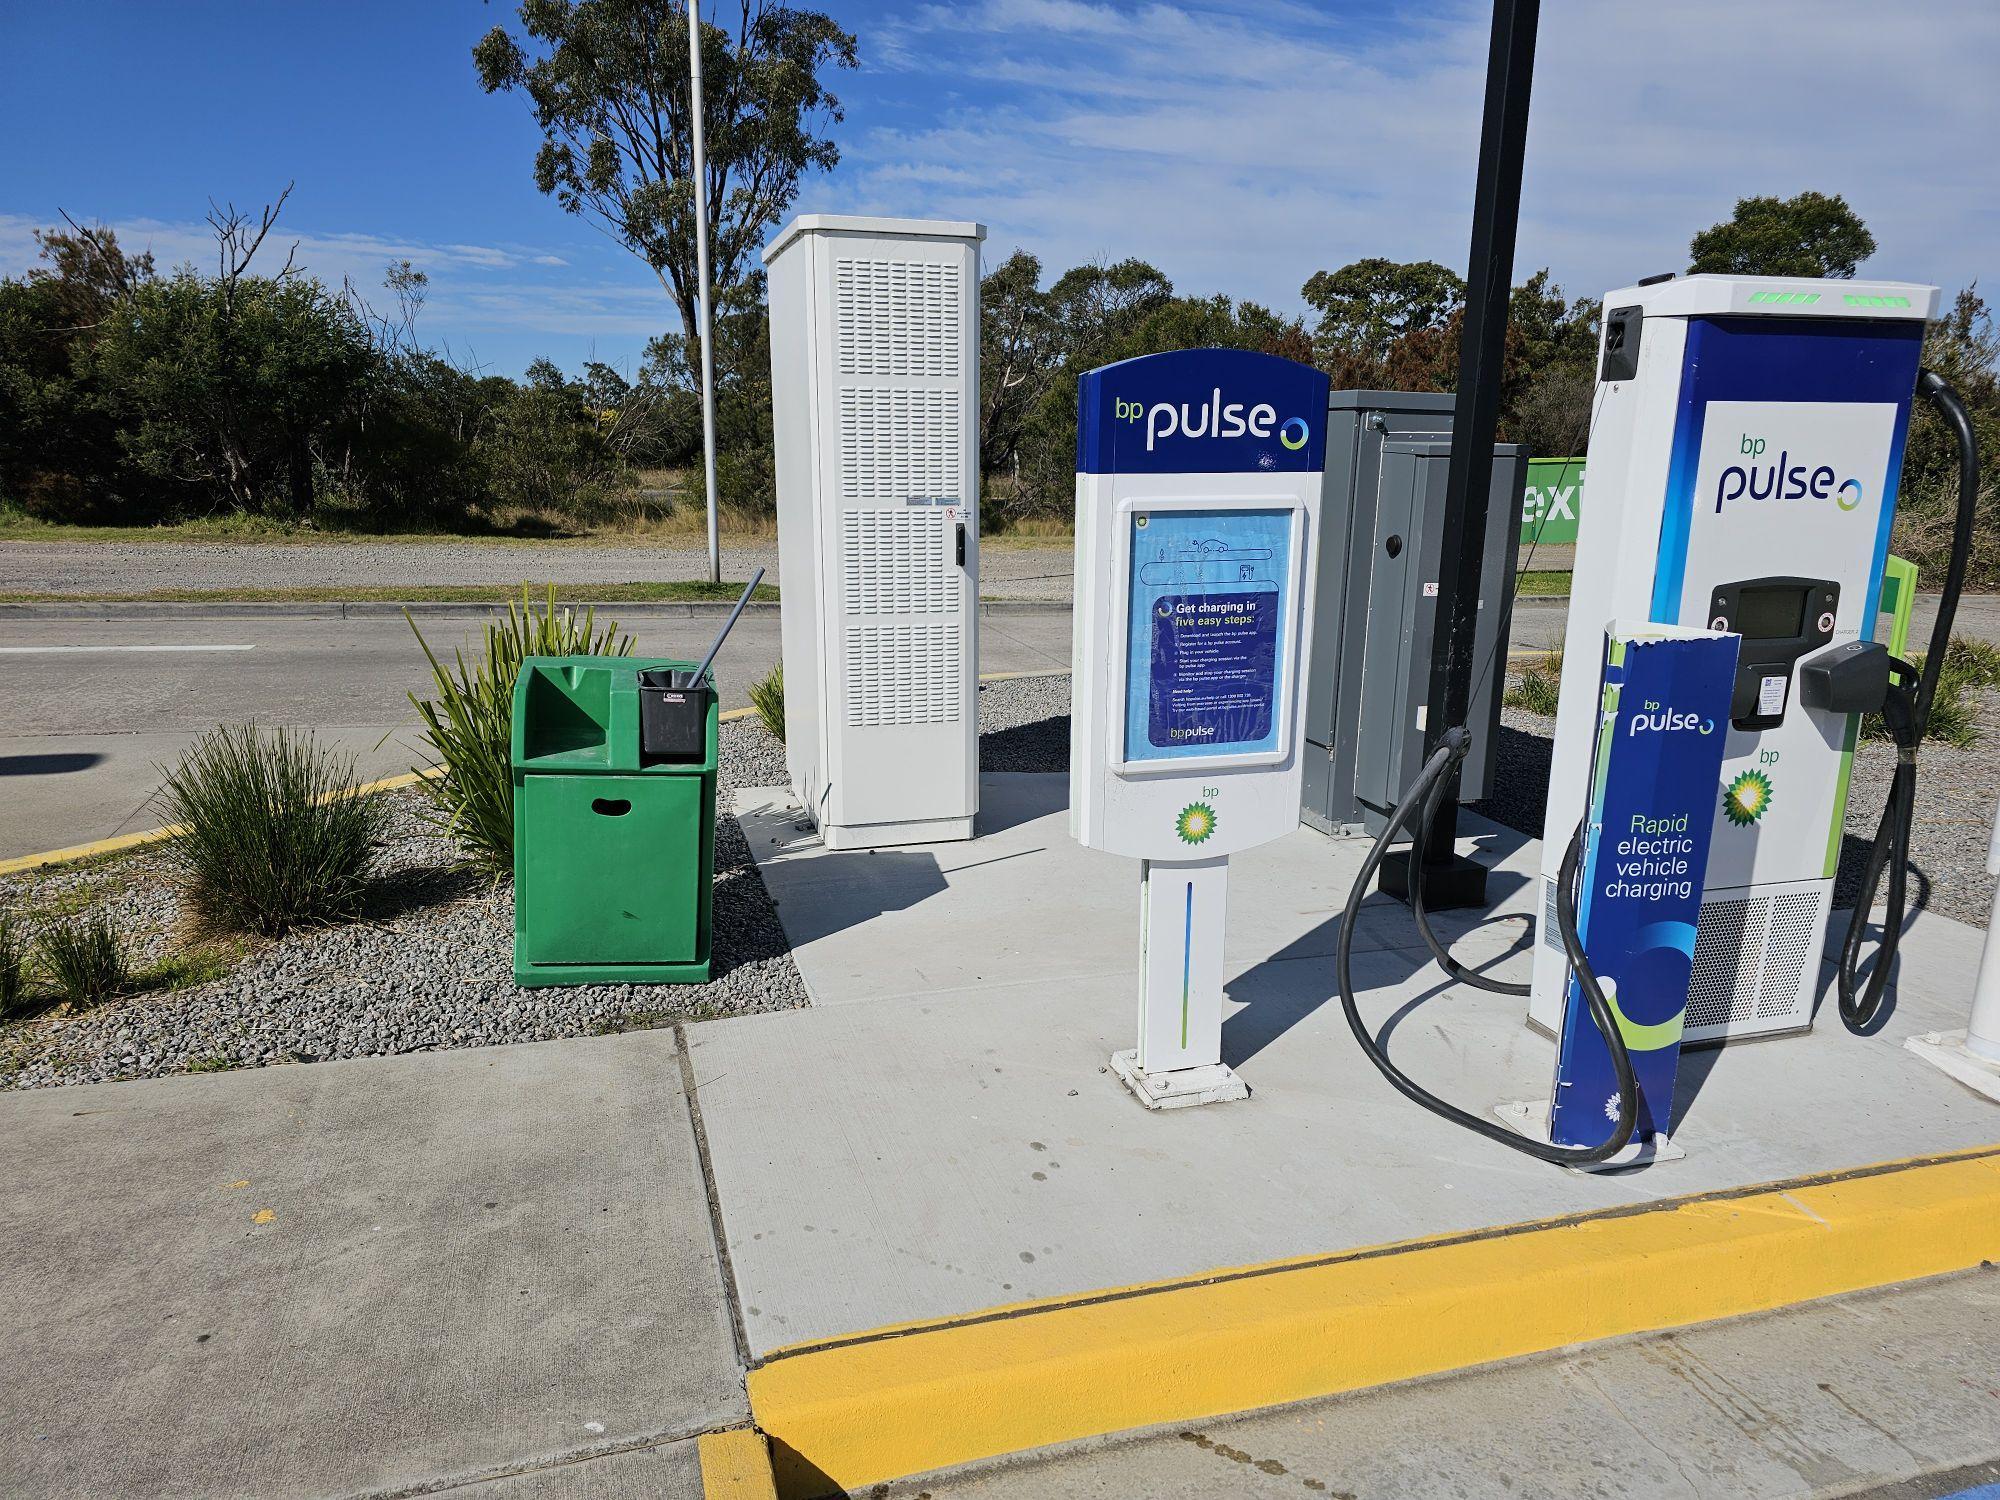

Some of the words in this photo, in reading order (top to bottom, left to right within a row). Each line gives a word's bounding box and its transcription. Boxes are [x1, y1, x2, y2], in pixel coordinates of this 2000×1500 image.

[1115, 397, 1144, 424] bp
[1146, 388, 1276, 451] pulse
[1740, 433, 1766, 459] bp
[1715, 450, 1835, 514] pulse
[1176, 604, 1196, 614] Get
[1198, 602, 1244, 614] charging
[1246, 601, 1256, 610] in
[1176, 616, 1194, 626] five
[1198, 617, 1222, 626] easy
[1224, 615, 1254, 626] steps:
[1644, 700, 1660, 711] bp
[1630, 708, 1699, 736] pulse
[1759, 748, 1780, 766] bp
[1203, 786, 1219, 799] bp
[1631, 814, 1688, 836] Rapid
[1617, 835, 1692, 854] electric
[1616, 857, 1688, 876] vehicle
[1606, 878, 1692, 900] charging
